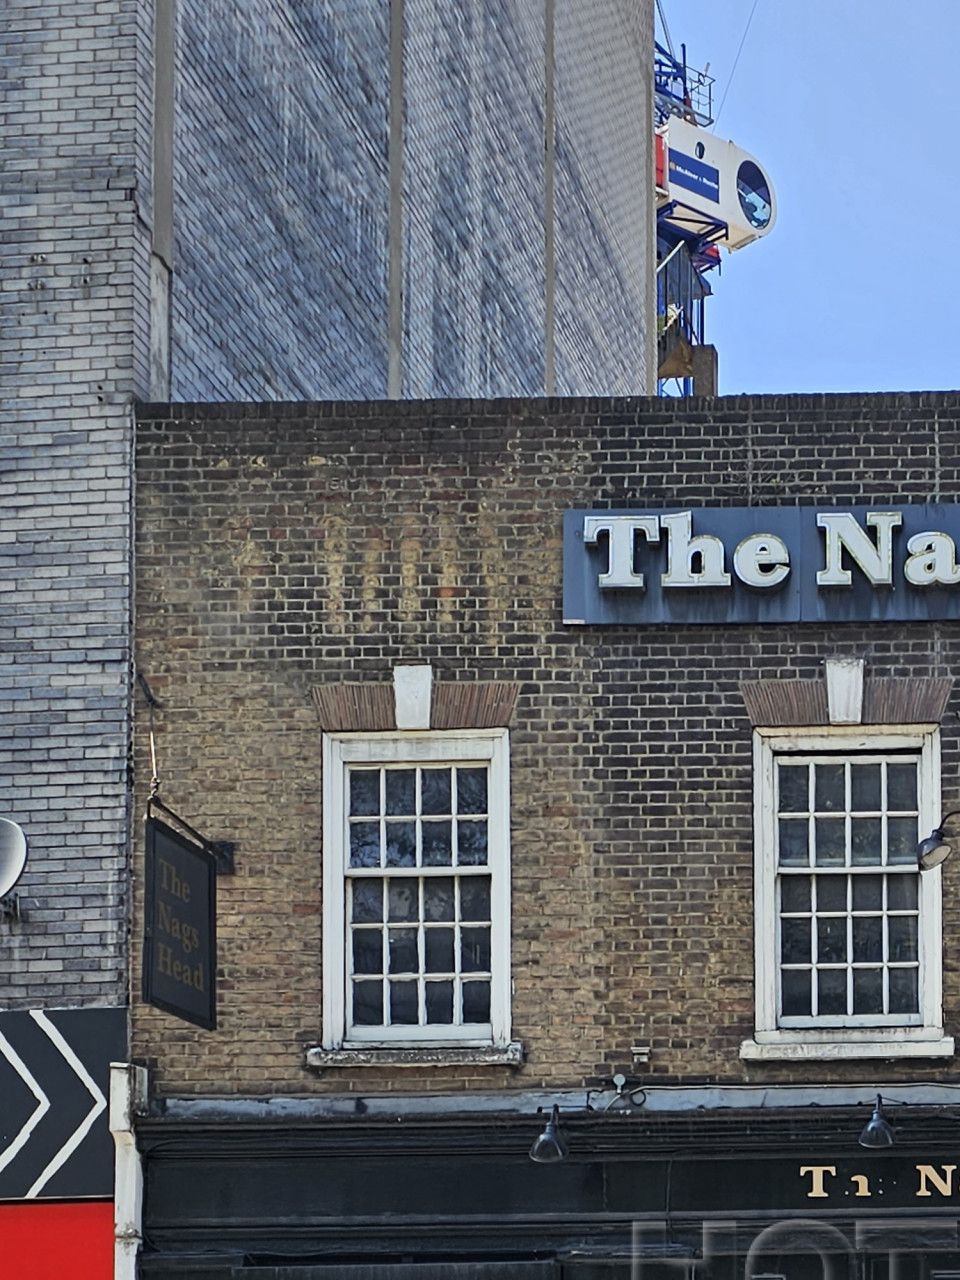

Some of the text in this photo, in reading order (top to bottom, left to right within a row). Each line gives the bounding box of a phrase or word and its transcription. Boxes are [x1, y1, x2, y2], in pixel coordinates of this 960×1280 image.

[583, 511, 790, 588] The
[159, 859, 191, 903] The
[158, 900, 199, 952] Nags
[158, 943, 204, 993] Head
